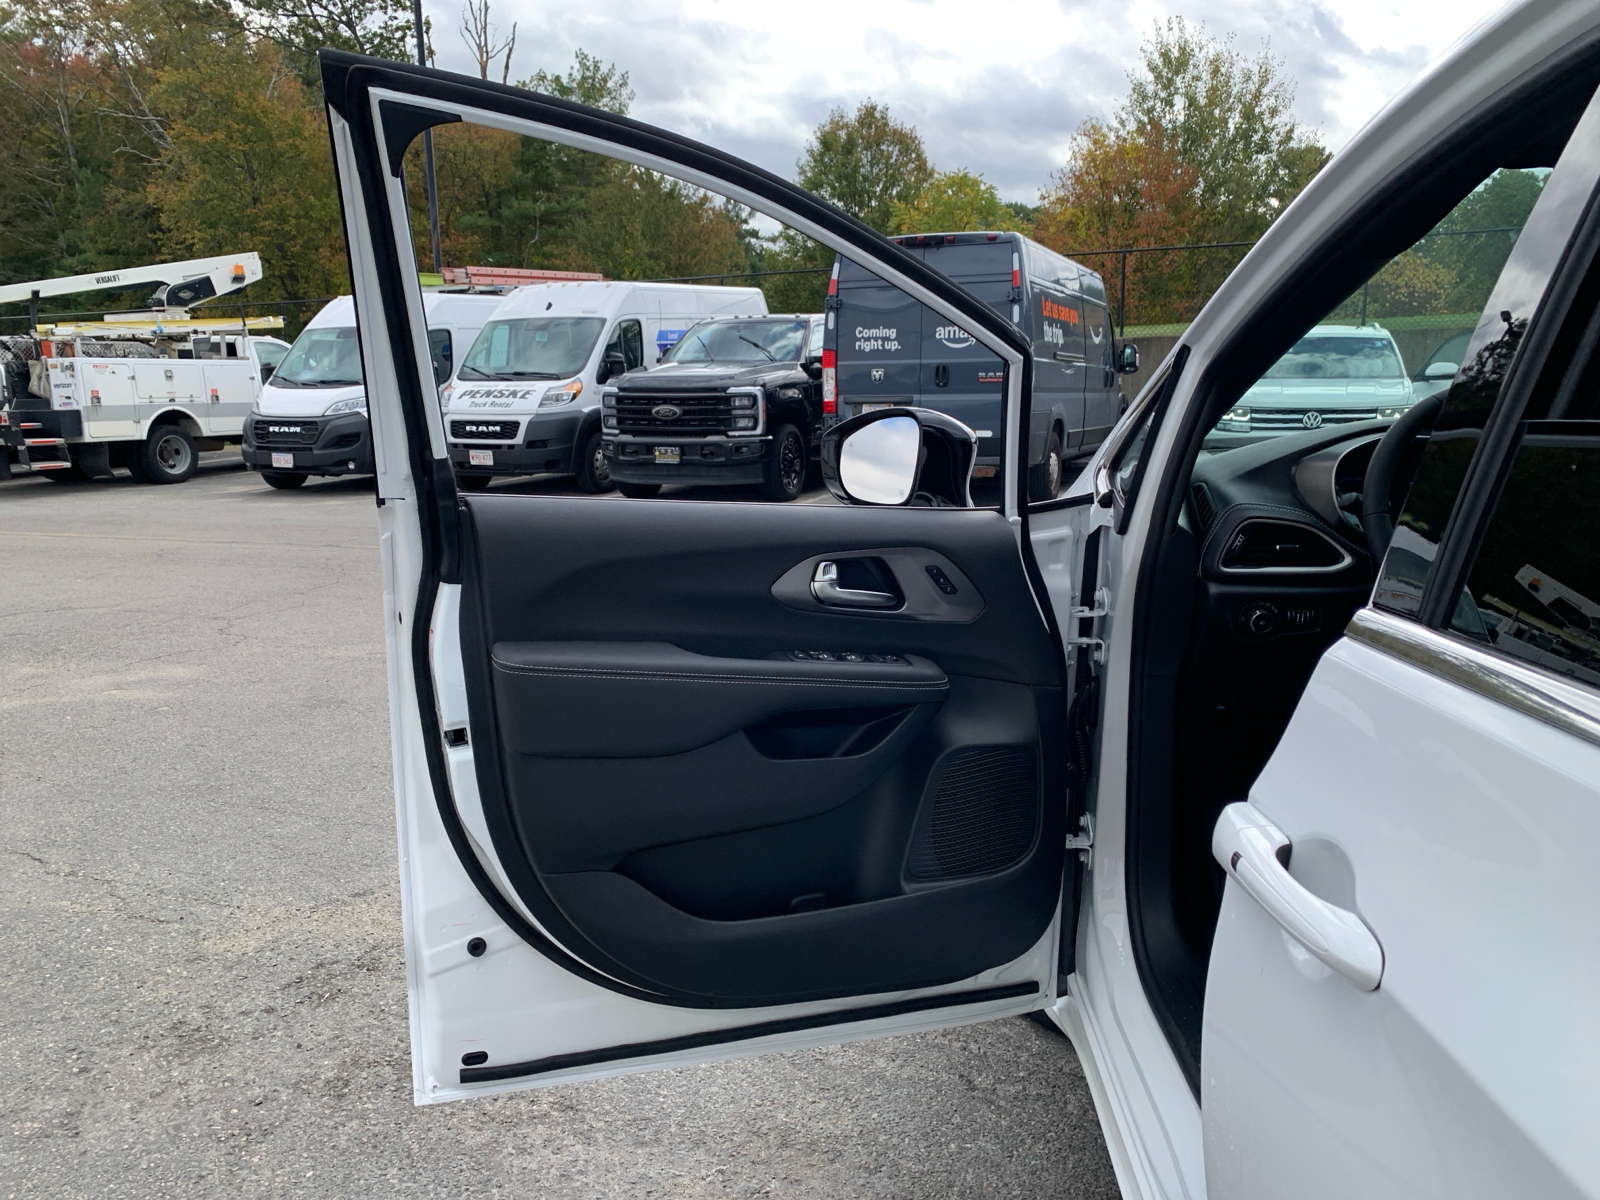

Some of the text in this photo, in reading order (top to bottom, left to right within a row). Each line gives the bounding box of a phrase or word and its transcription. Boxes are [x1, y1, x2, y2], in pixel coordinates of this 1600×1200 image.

[94, 274, 121, 284] VERSALIFT
[1042, 294, 1052, 317] Let
[1058, 304, 1069, 322] save
[1069, 308, 1078, 327] you
[855, 326, 897, 339] Coming
[935, 326, 970, 339] ama
[1043, 320, 1064, 347] the trip.
[855, 339, 902, 352] right up.
[456, 389, 538, 399] PENSKE
